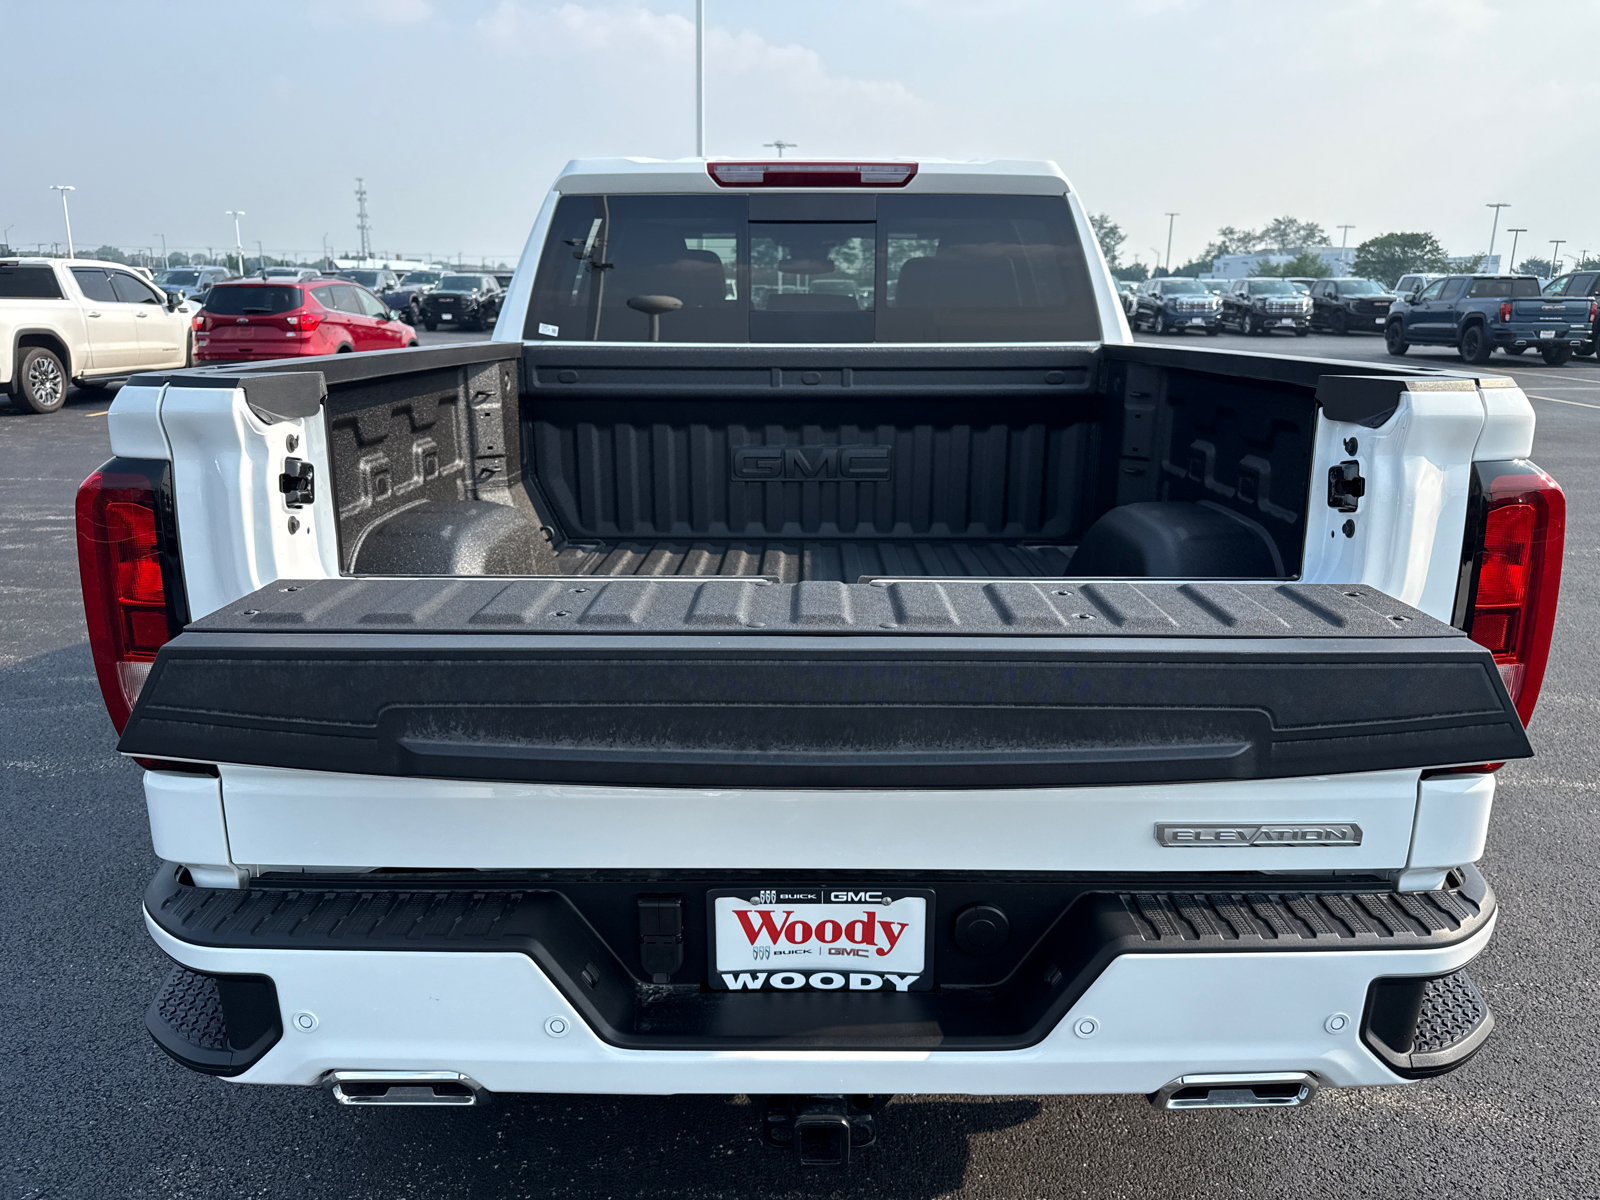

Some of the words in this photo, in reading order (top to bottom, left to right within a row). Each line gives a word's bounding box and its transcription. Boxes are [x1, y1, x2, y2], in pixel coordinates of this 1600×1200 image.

[734, 449, 889, 479] GMC
[1171, 828, 1348, 842] ELEVATION
[830, 891, 883, 902] GMC
[732, 910, 909, 957] Woody
[828, 947, 870, 958] GMC
[721, 972, 920, 992] WOODY
